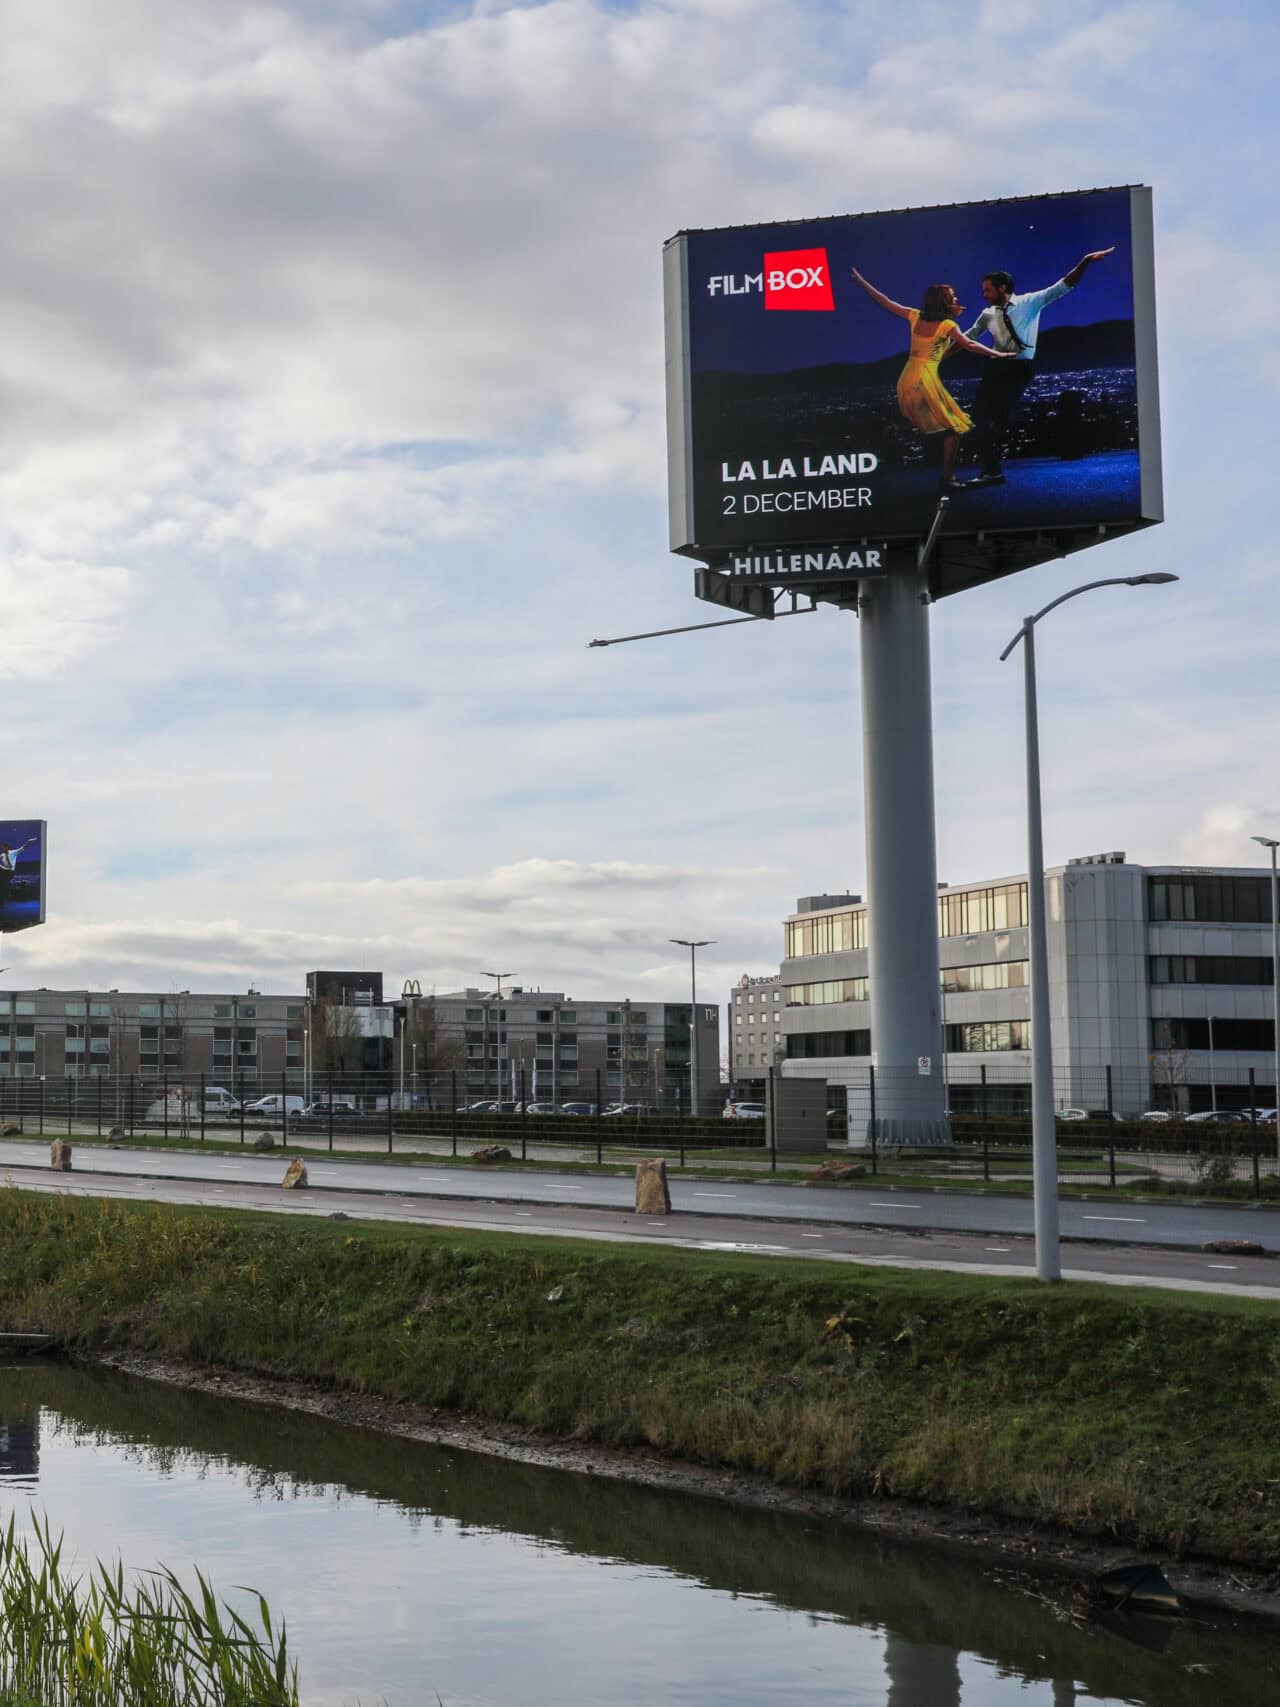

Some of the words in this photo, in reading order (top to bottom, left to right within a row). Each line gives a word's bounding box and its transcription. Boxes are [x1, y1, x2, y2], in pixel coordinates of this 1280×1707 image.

[721, 460, 757, 482] LA
[762, 457, 797, 480] LA
[803, 453, 879, 477] LAND
[722, 495, 737, 515] 2
[743, 488, 873, 514] DECEMBER
[733, 549, 882, 576] HILLENAAR
